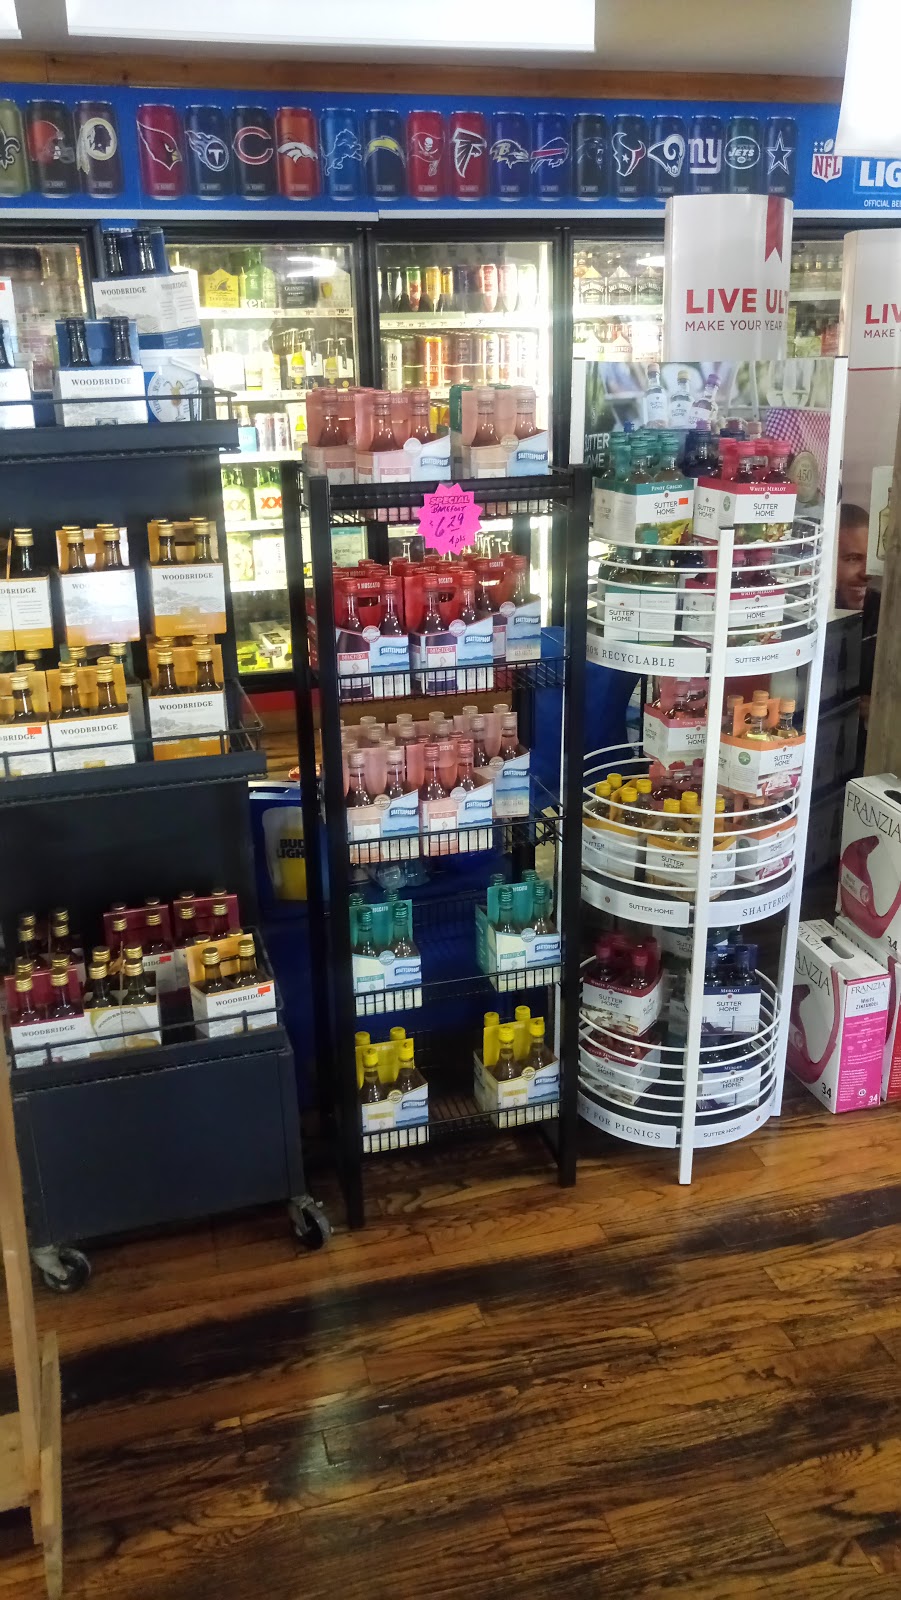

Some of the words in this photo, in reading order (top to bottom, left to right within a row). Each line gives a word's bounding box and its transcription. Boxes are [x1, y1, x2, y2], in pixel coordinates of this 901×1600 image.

[728, 149, 755, 157] JETS
[813, 155, 842, 179] NFL
[863, 200, 890, 208] OFFICIAL
[100, 286, 147, 296] WOODBRIDGE
[686, 288, 758, 315] LIVE
[685, 320, 725, 332] MAKE
[730, 319, 762, 332] YOUR
[764, 320, 783, 332] YEAR
[864, 328, 896, 339] MAKE
[71, 376, 132, 387] WOODBRIDGE
[429, 495, 470, 505] SPECIAL
[654, 501, 678, 509] SUTTER
[656, 508, 675, 516] HOME
[162, 572, 214, 581] WOODBRIDGE
[746, 611, 766, 619] HOME
[601, 649, 676, 668] RECYCLABLE
[761, 653, 780, 662] HOME
[159, 700, 214, 711] WOODBRIDGE
[60, 724, 119, 735] WOODBRIDGE
[661, 855, 685, 867] SUTTER
[628, 902, 653, 913] SUTTER
[850, 982, 886, 994] FRANZIA
[21, 1024, 76, 1037] WOODBRIDGE
[722, 1081, 742, 1089] HOME
[821, 1082, 832, 1099] 34
[869, 1094, 879, 1102] 34
[593, 1112, 611, 1126] FOR
[615, 1122, 661, 1140] PICNICS
[703, 1129, 725, 1138] SUTTER
[725, 1124, 742, 1134] HOME
